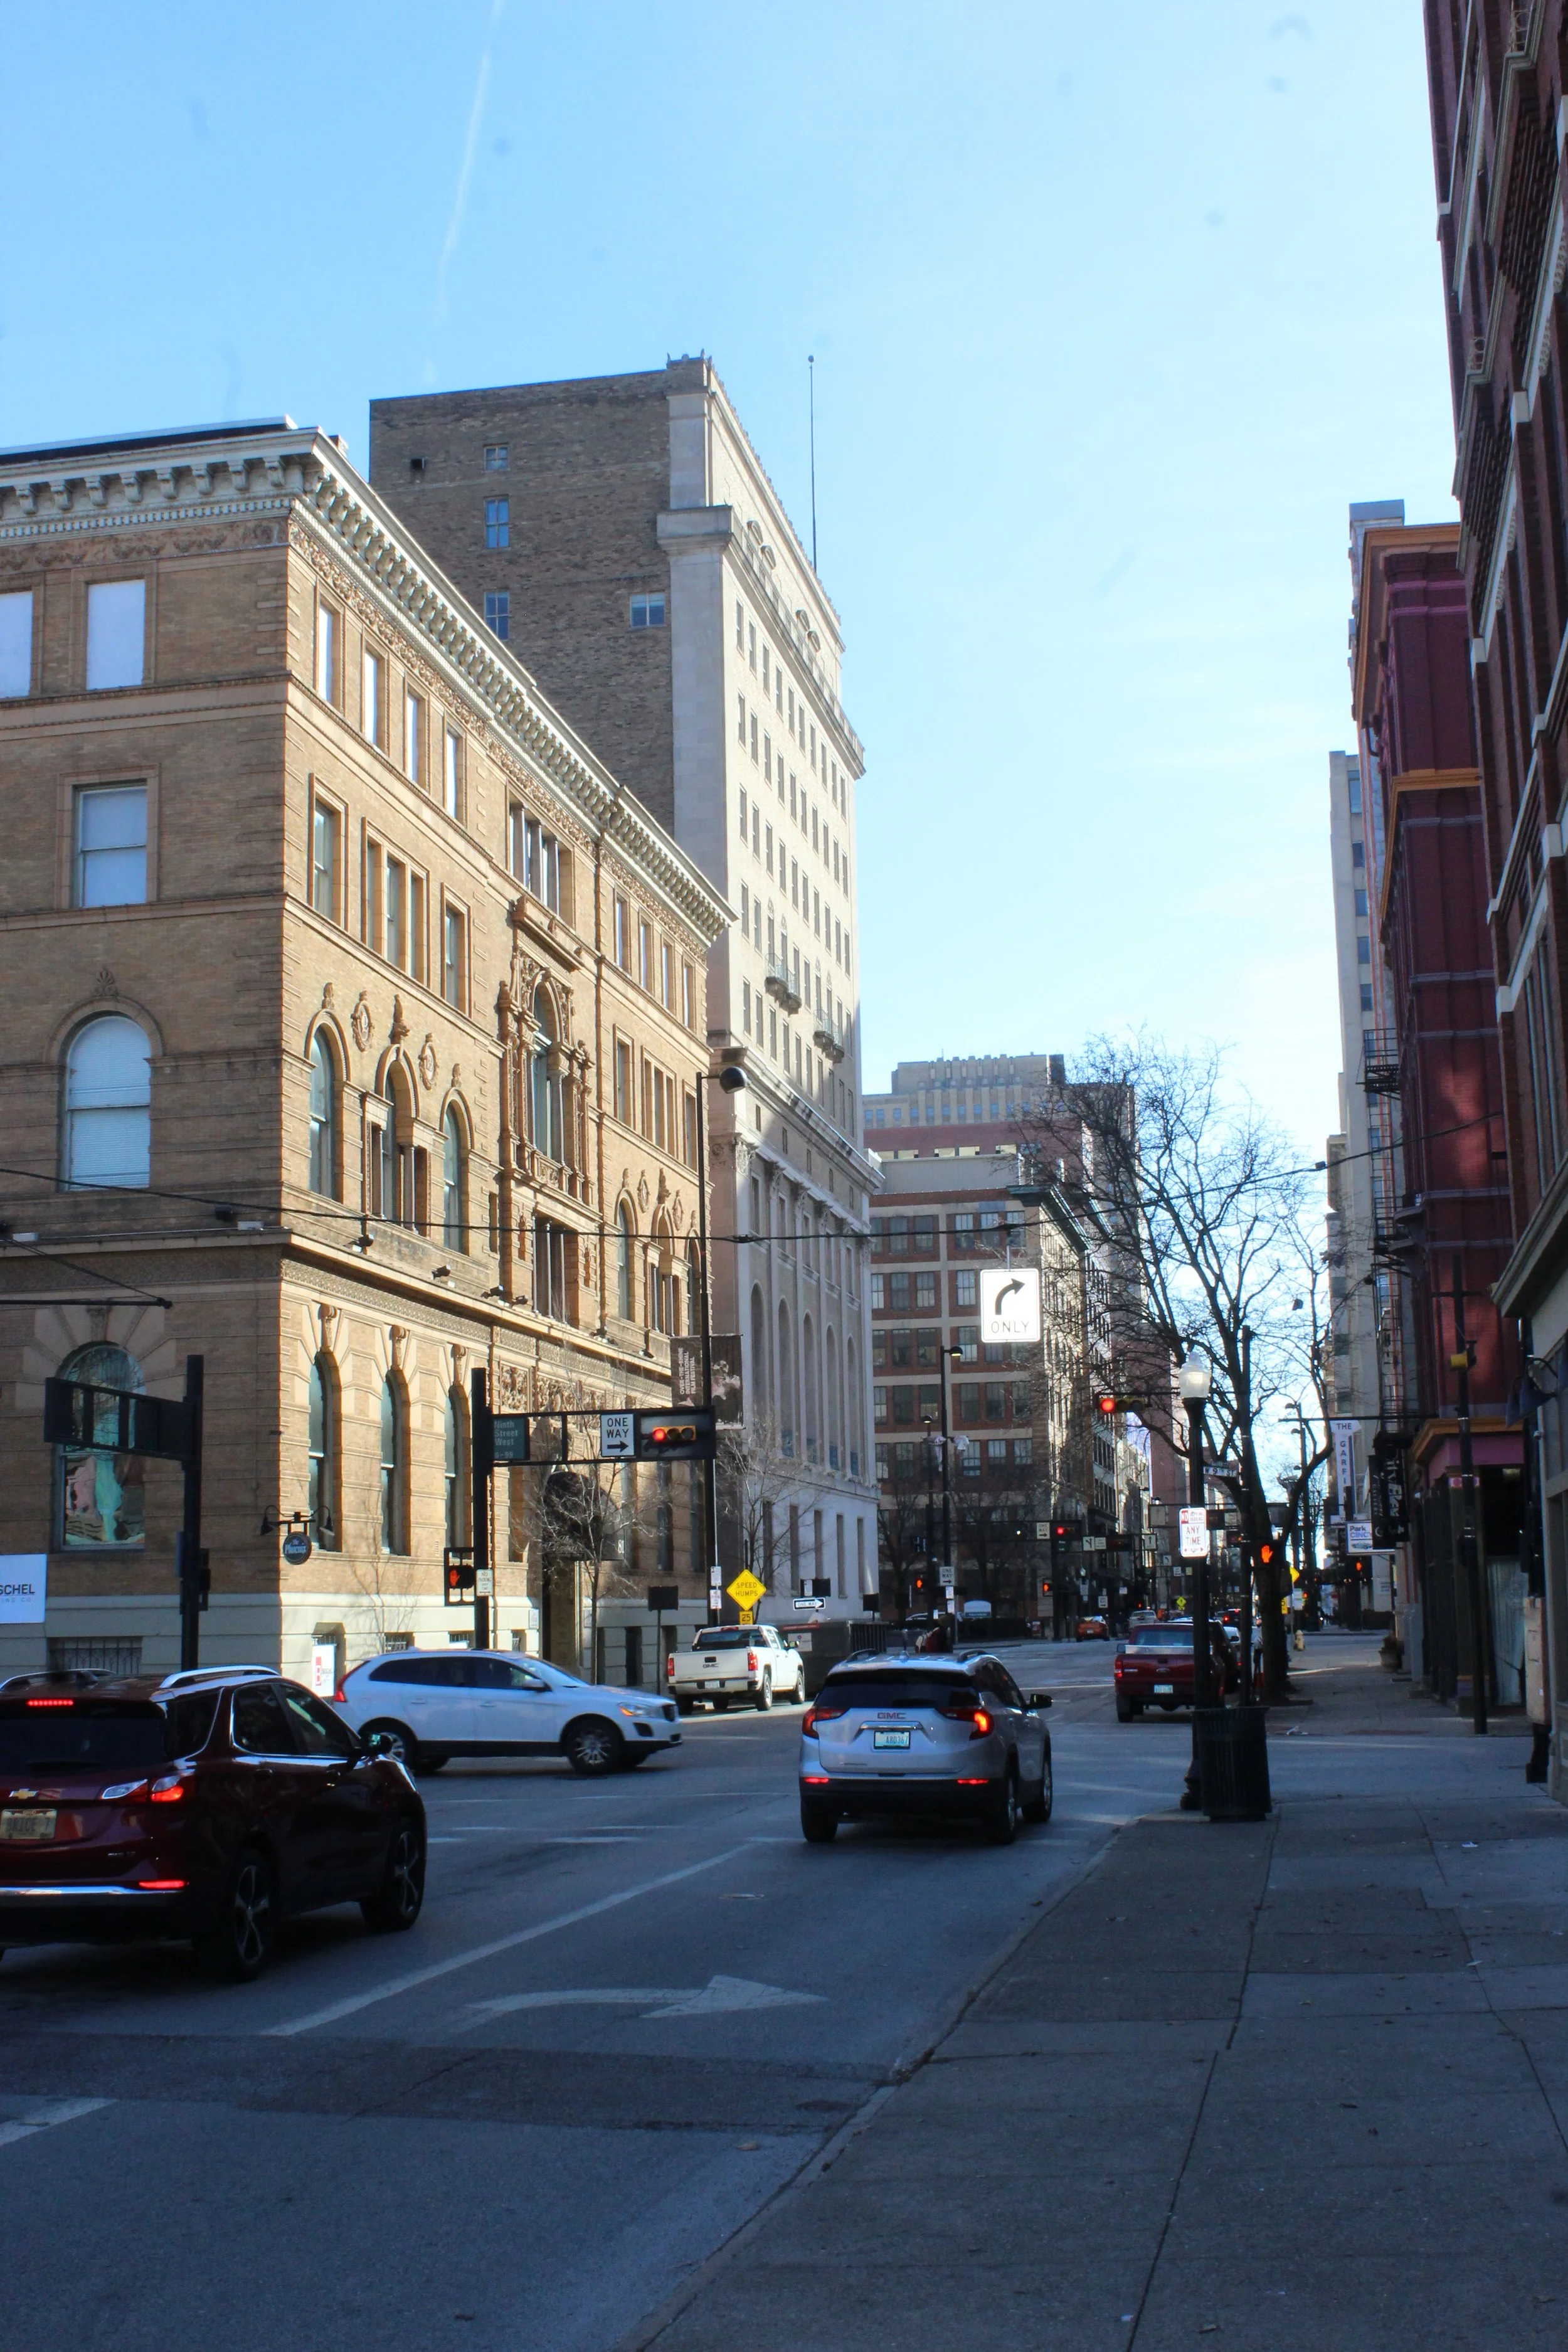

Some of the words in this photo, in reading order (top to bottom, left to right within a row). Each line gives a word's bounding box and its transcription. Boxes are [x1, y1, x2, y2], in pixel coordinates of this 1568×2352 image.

[992, 1321, 1029, 1333] ONLY
[494, 1420, 514, 1428] Ninth
[607, 1417, 628, 1427] ONE
[607, 1429, 629, 1438] WAY
[1187, 1525, 1200, 1534] ANY
[1186, 1537, 1201, 1545] TIME
[618, 1540, 625, 1554] 81
[741, 1614, 751, 1622] 25
